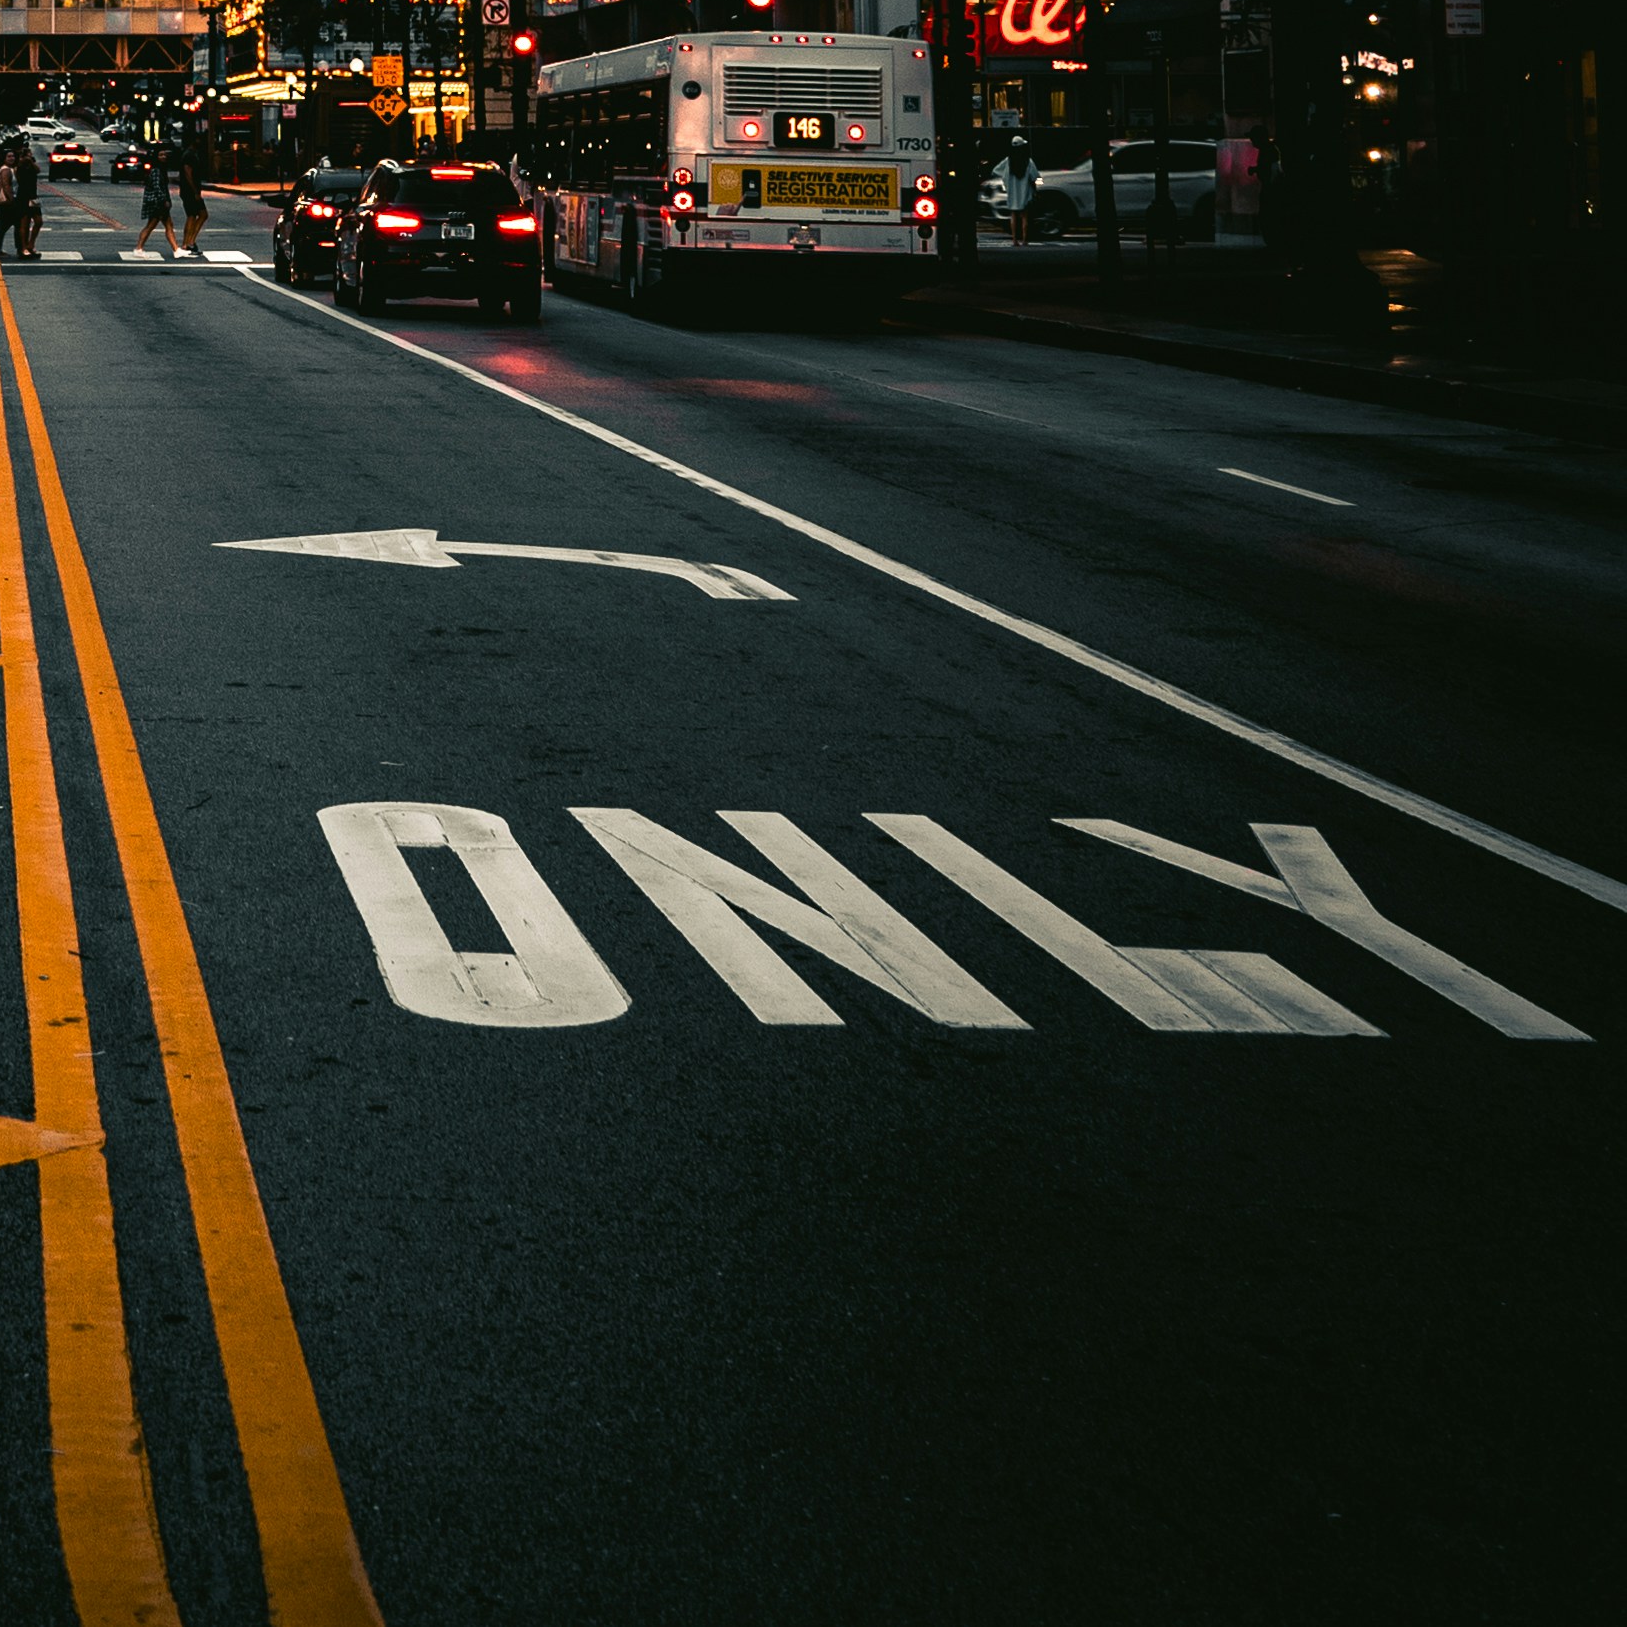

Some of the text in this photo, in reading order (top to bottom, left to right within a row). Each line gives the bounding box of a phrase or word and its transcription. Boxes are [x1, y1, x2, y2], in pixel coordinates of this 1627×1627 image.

[787, 116, 822, 139] 146
[897, 137, 932, 152] 1730
[767, 170, 889, 184] SELECTIVE SERVICE
[767, 181, 889, 198] REGISTRATION
[767, 196, 808, 205] UNLOCKS
[849, 199, 889, 207] BENEFITS
[316, 801, 1593, 1041] ONLY
